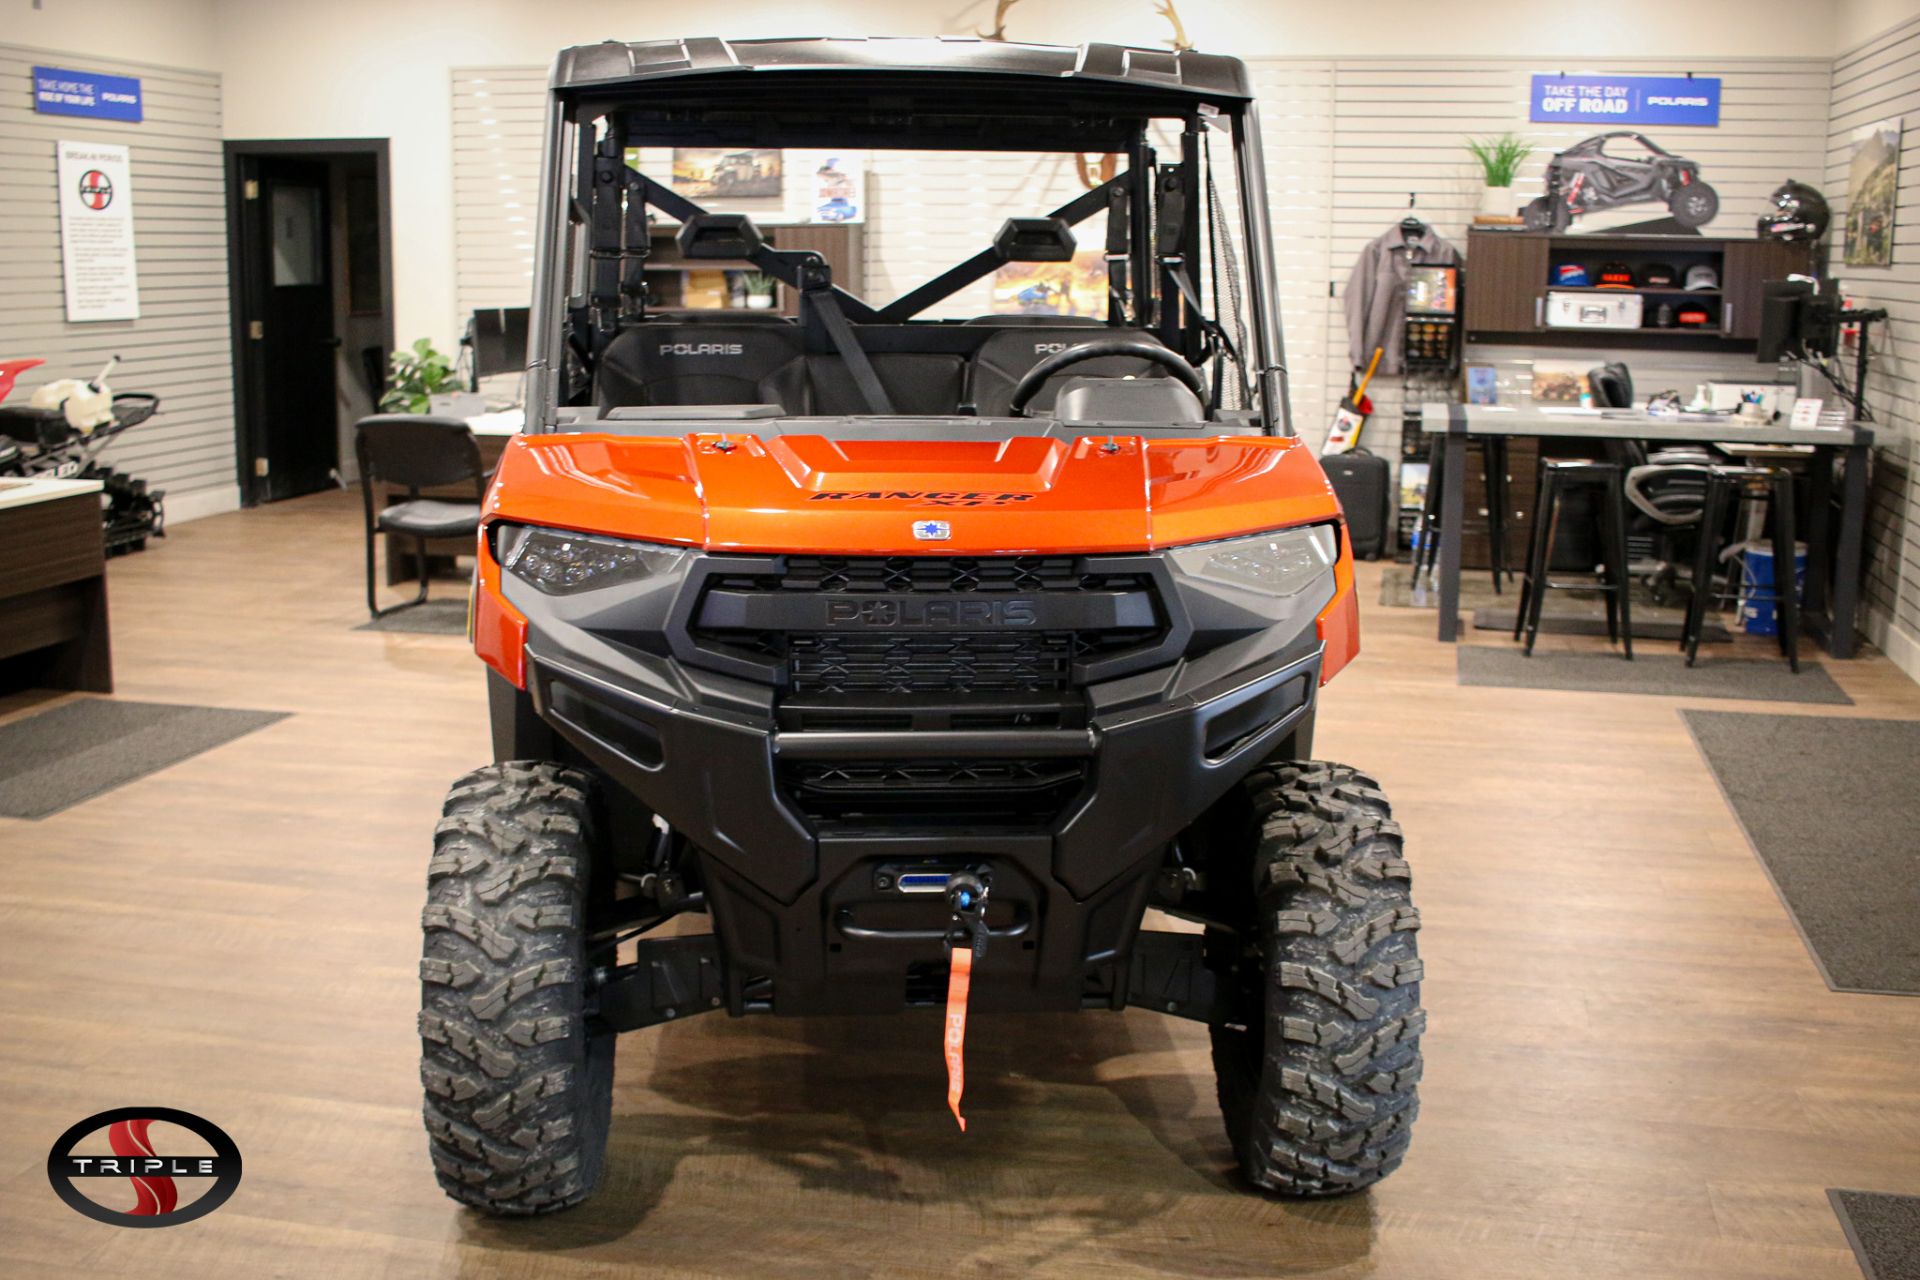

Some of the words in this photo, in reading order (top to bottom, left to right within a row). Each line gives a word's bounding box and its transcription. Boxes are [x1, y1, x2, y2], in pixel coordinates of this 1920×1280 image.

[1544, 85, 1575, 97] TAKE
[1579, 86, 1601, 97] THE
[1604, 86, 1629, 98] DAY
[1542, 97, 1575, 113] OFF
[1579, 98, 1629, 114] ROAD
[1647, 96, 1708, 107] POLARIS
[659, 343, 743, 356] POLARIS
[810, 492, 1035, 501] RANGER
[826, 600, 1037, 627] POLARIS
[948, 1013, 963, 1093] POLARIS
